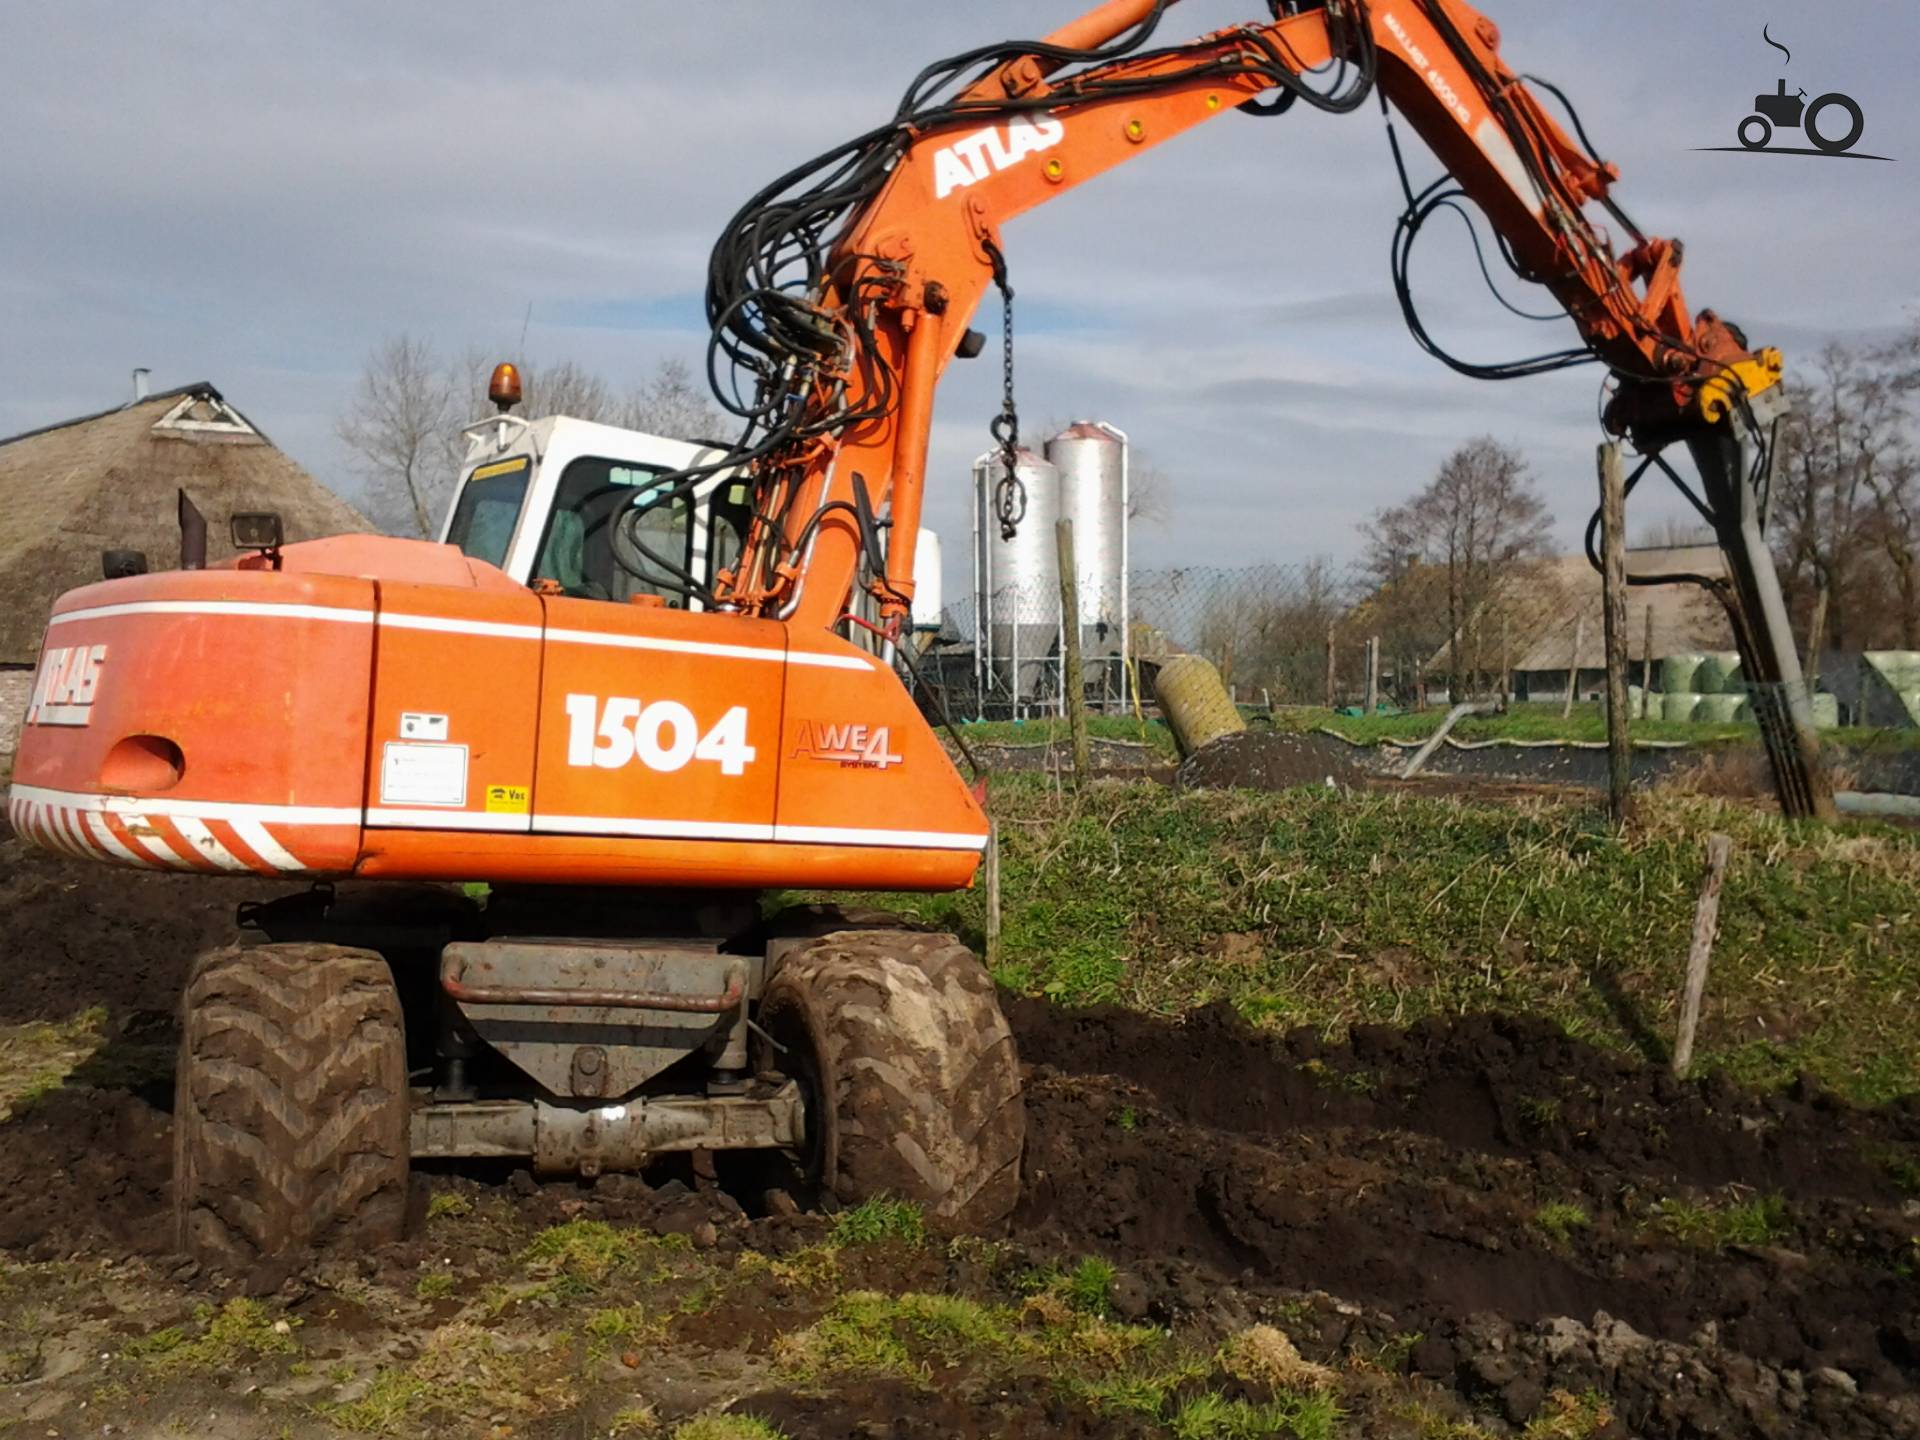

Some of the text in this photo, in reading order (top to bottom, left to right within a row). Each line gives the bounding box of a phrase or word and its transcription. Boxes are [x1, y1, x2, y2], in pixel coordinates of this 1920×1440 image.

[933, 113, 1065, 199] ATLAS
[27, 644, 107, 726] ATLAS
[566, 694, 755, 775] 1504
